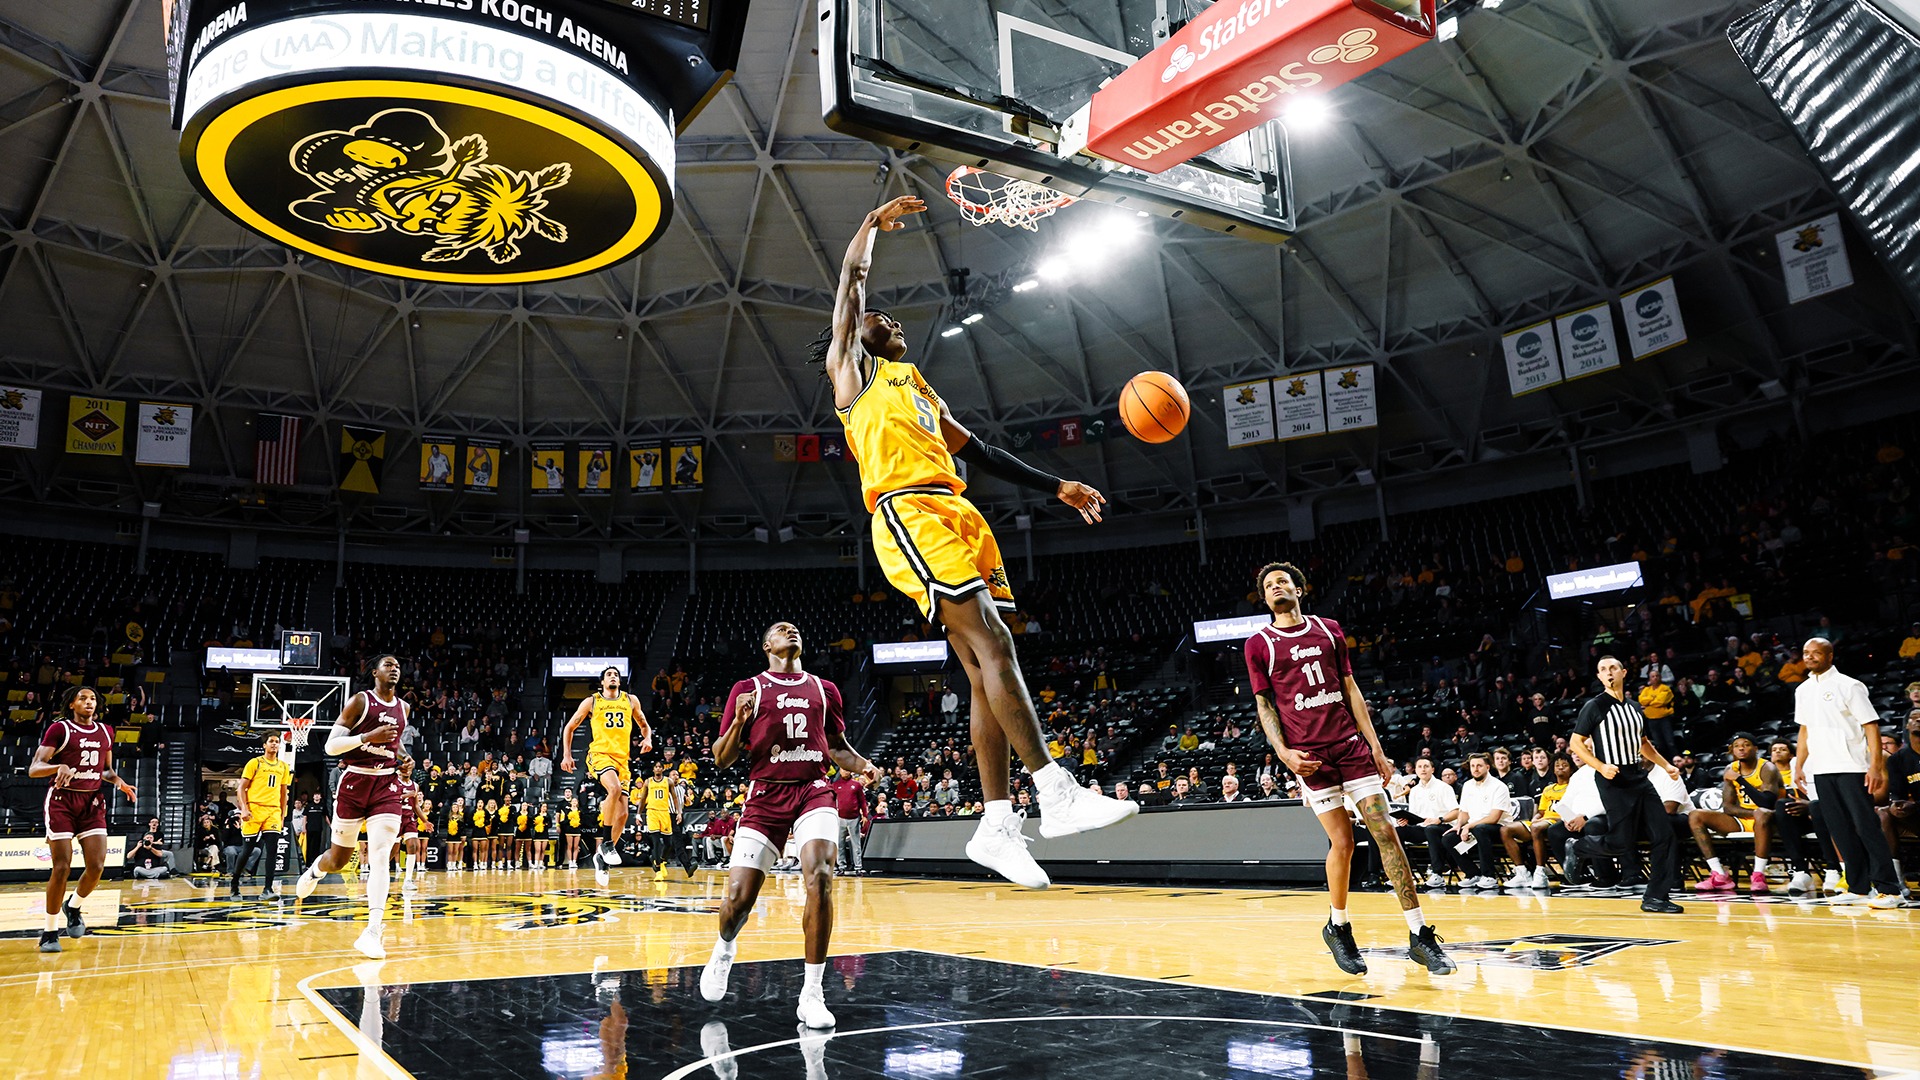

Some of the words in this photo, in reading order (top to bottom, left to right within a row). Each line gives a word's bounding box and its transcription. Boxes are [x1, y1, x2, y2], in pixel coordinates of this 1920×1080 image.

[663, 4, 671, 16] 2
[692, 12, 699, 24] 1
[198, 2, 247, 53] ARENA
[274, 31, 335, 58] IMA
[481, 0, 553, 34] KOCH
[557, 17, 629, 76] ARENA
[361, 22, 524, 82] Making
[536, 59, 556, 87] a
[208, 49, 248, 88] are
[1647, 332, 1669, 347] 2015
[1580, 356, 1603, 369] 2014
[1525, 372, 1547, 386] 2013
[85, 399, 110, 411] 2011
[912, 393, 936, 434] 5
[1342, 415, 1362, 425] 2015
[85, 421, 110, 430] NIT
[1292, 423, 1311, 433] 2014
[154, 434, 174, 442] 2019
[1242, 429, 1260, 440] 2013
[72, 439, 117, 452] CHAMPIONS
[1289, 644, 1322, 662] Texas
[1301, 660, 1326, 687] 11
[776, 692, 809, 710] Texas
[1294, 688, 1343, 711] Southern
[604, 712, 625, 728] 33
[782, 713, 808, 739] 12
[80, 750, 99, 766] 20
[770, 744, 823, 763] Southern
[267, 774, 277, 788] 11
[655, 789, 664, 799] 10
